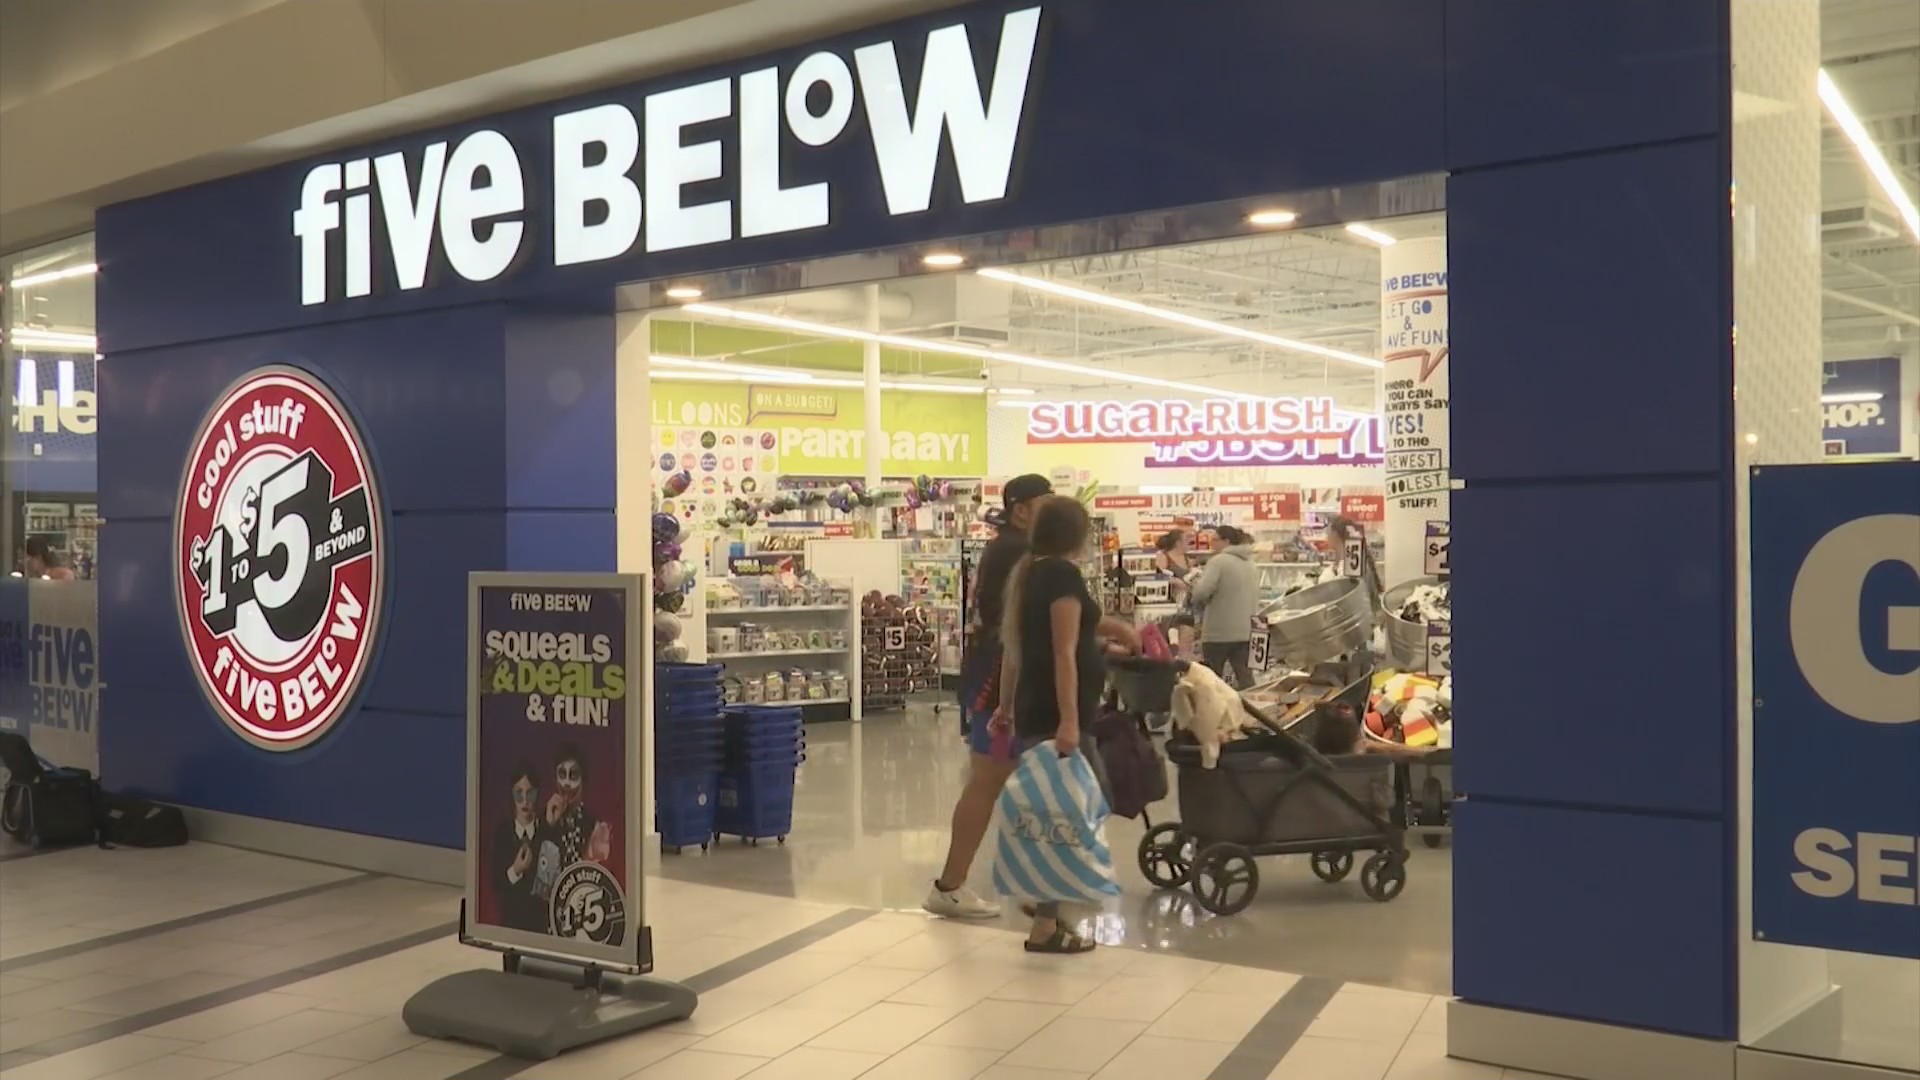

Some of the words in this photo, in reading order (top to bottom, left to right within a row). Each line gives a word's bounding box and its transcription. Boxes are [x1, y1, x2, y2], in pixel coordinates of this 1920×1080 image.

[294, 129, 525, 306] five
[553, 6, 1042, 266] BELOW
[1404, 315, 1412, 330] &
[1412, 299, 1432, 315] GO
[1388, 413, 1424, 434] YES!
[198, 422, 238, 509] cool
[239, 398, 306, 441] stuff
[329, 507, 343, 534] &
[314, 525, 366, 561] BEYOND
[231, 562, 249, 583] TO
[510, 593, 542, 611] five
[544, 594, 591, 612] BELOW
[29, 623, 94, 690] five
[212, 646, 277, 722] five
[281, 583, 364, 723] BELOW
[30, 686, 93, 733] BELOW
[526, 693, 546, 722] &
[1791, 827, 1920, 905] SE
